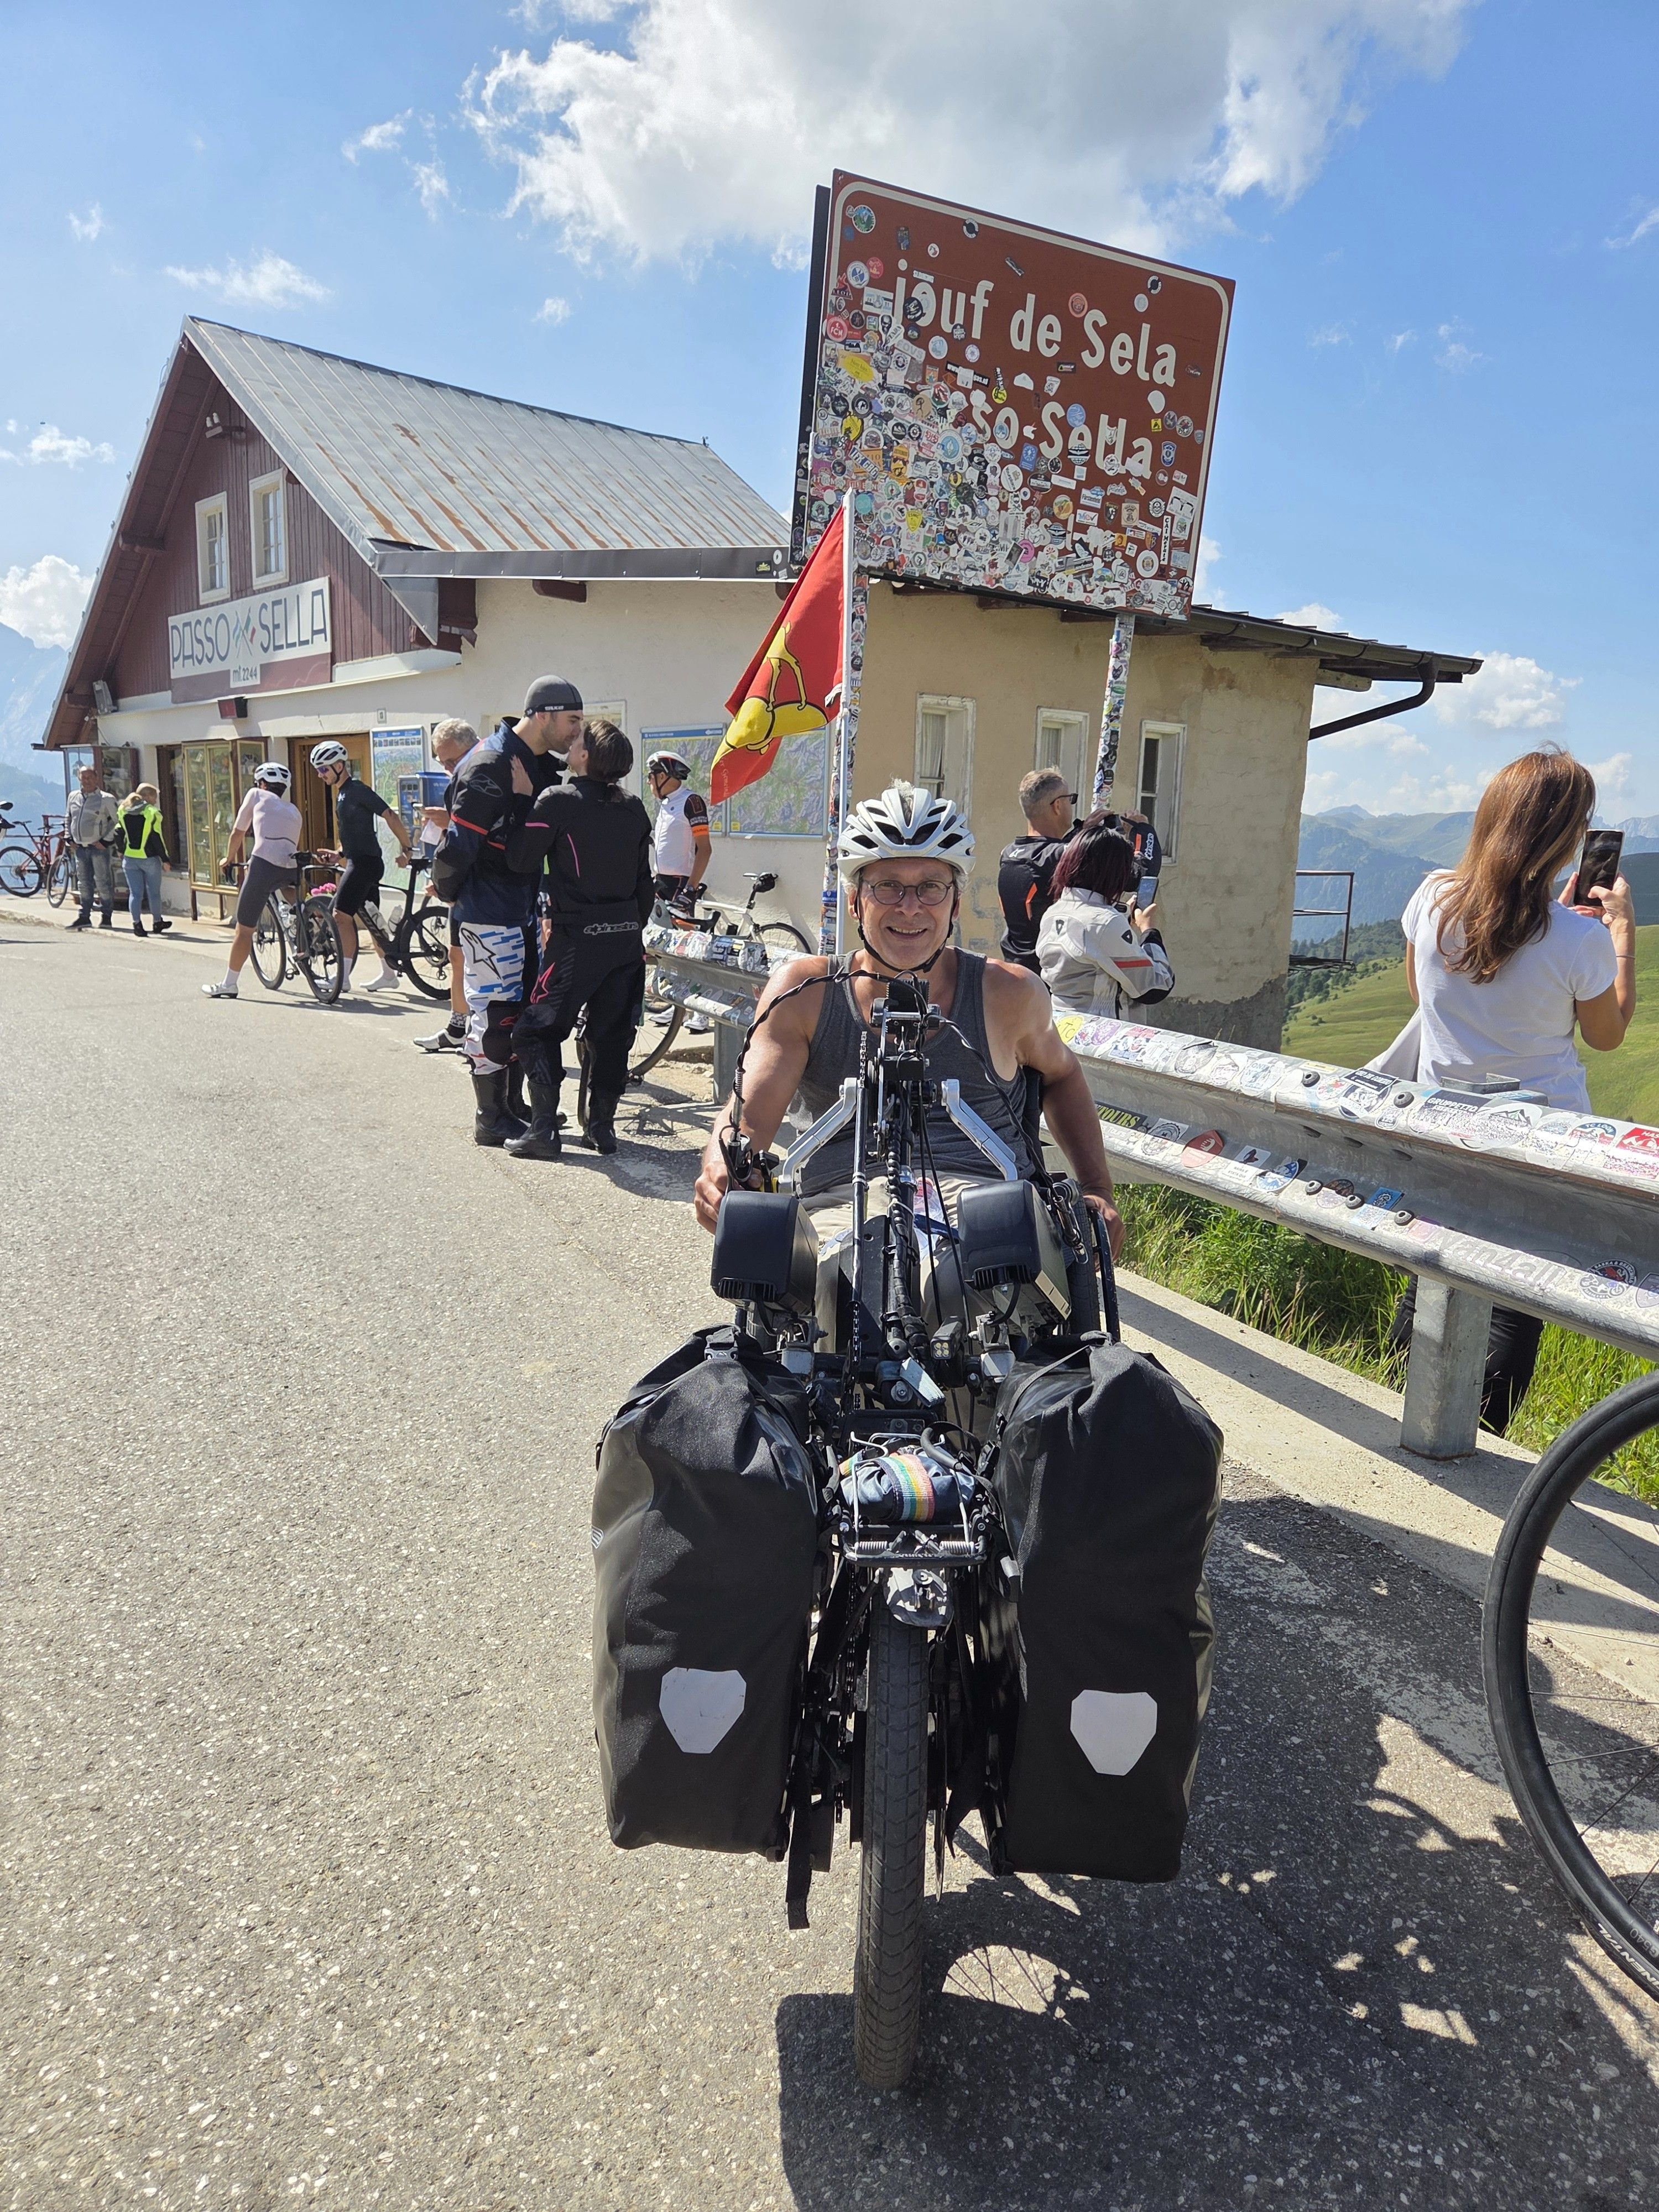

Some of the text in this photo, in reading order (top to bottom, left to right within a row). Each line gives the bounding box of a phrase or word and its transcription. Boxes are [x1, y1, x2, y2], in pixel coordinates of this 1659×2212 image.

[1010, 293, 1062, 357] de
[1081, 309, 1176, 387] Sela
[171, 588, 327, 670] PASSO SELLA
[1427, 1097, 1478, 1113] GRUPPETTO
[1630, 1928, 1658, 1958] G540
